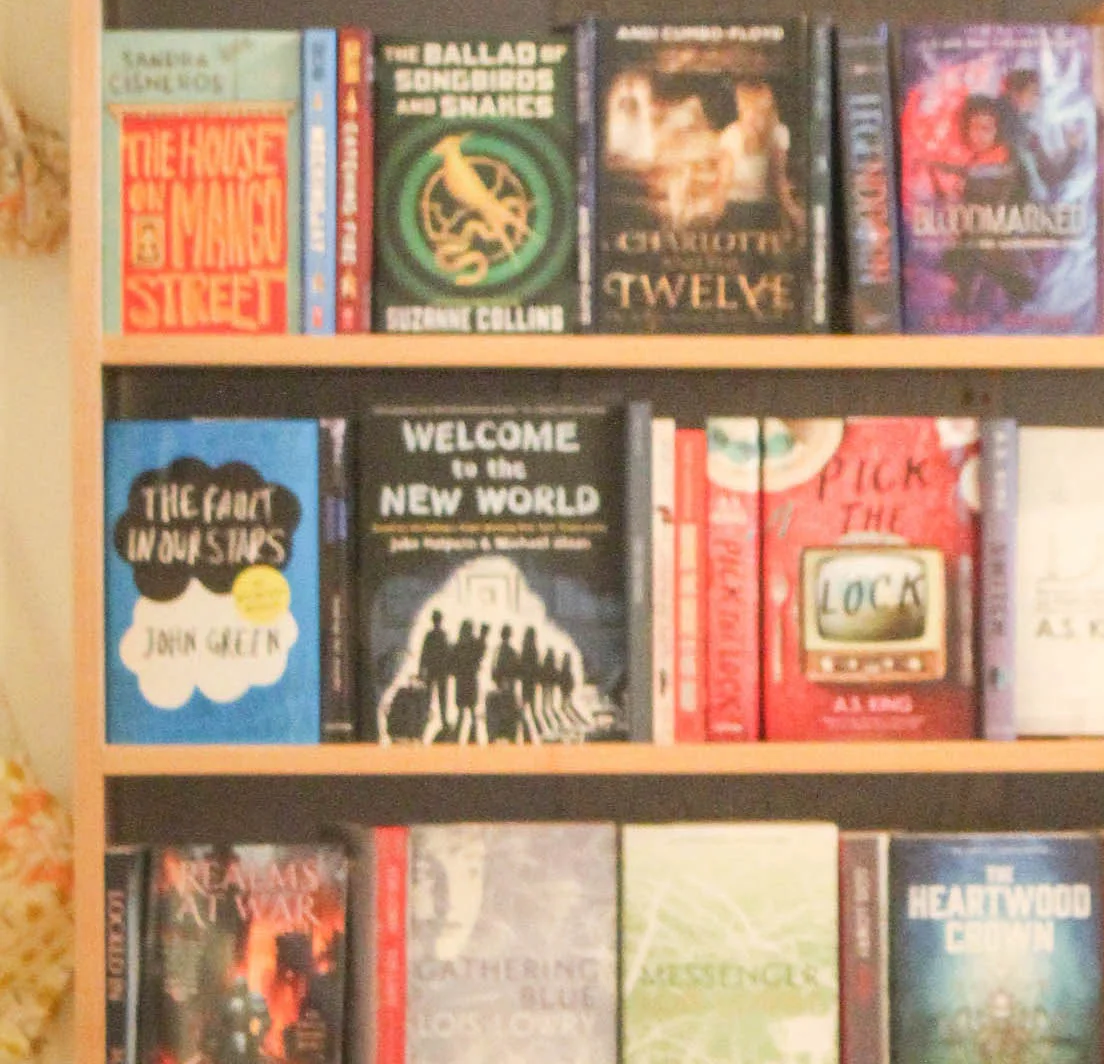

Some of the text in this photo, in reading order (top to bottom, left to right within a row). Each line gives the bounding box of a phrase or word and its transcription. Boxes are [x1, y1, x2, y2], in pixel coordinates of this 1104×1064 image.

[121, 49, 210, 71] SANDRA
[384, 46, 420, 64] THE
[423, 41, 537, 67] BALLAD
[107, 70, 224, 96] CISNEROS
[394, 68, 555, 92] SONGBIRDS
[439, 95, 554, 119] SNAKES
[122, 122, 286, 178] THE HOUSE
[170, 179, 284, 271] MANGO
[126, 269, 288, 330] STREET
[602, 271, 794, 317] TWELVE
[385, 305, 566, 333] SUZANNE COLLINS
[401, 418, 582, 454] WELCOME
[450, 454, 528, 481] to the
[816, 454, 931, 502] PICK
[140, 482, 274, 526] THE FAULT
[379, 482, 601, 519] NEW WORLD
[838, 500, 907, 535] THE
[126, 527, 286, 568] IN OUR STARS
[819, 569, 929, 618] LOCK
[142, 625, 281, 661] JOHN GREEN
[984, 862, 1014, 885] THE
[239, 892, 323, 929] WAR
[906, 883, 1094, 921] HEARTWOOD
[944, 919, 1056, 957] CROWN
[414, 956, 600, 984] GATHERING
[638, 959, 820, 990] MESSENGER
[519, 984, 598, 1010] BLUE
[417, 1009, 598, 1039] LOIS LOWRY
